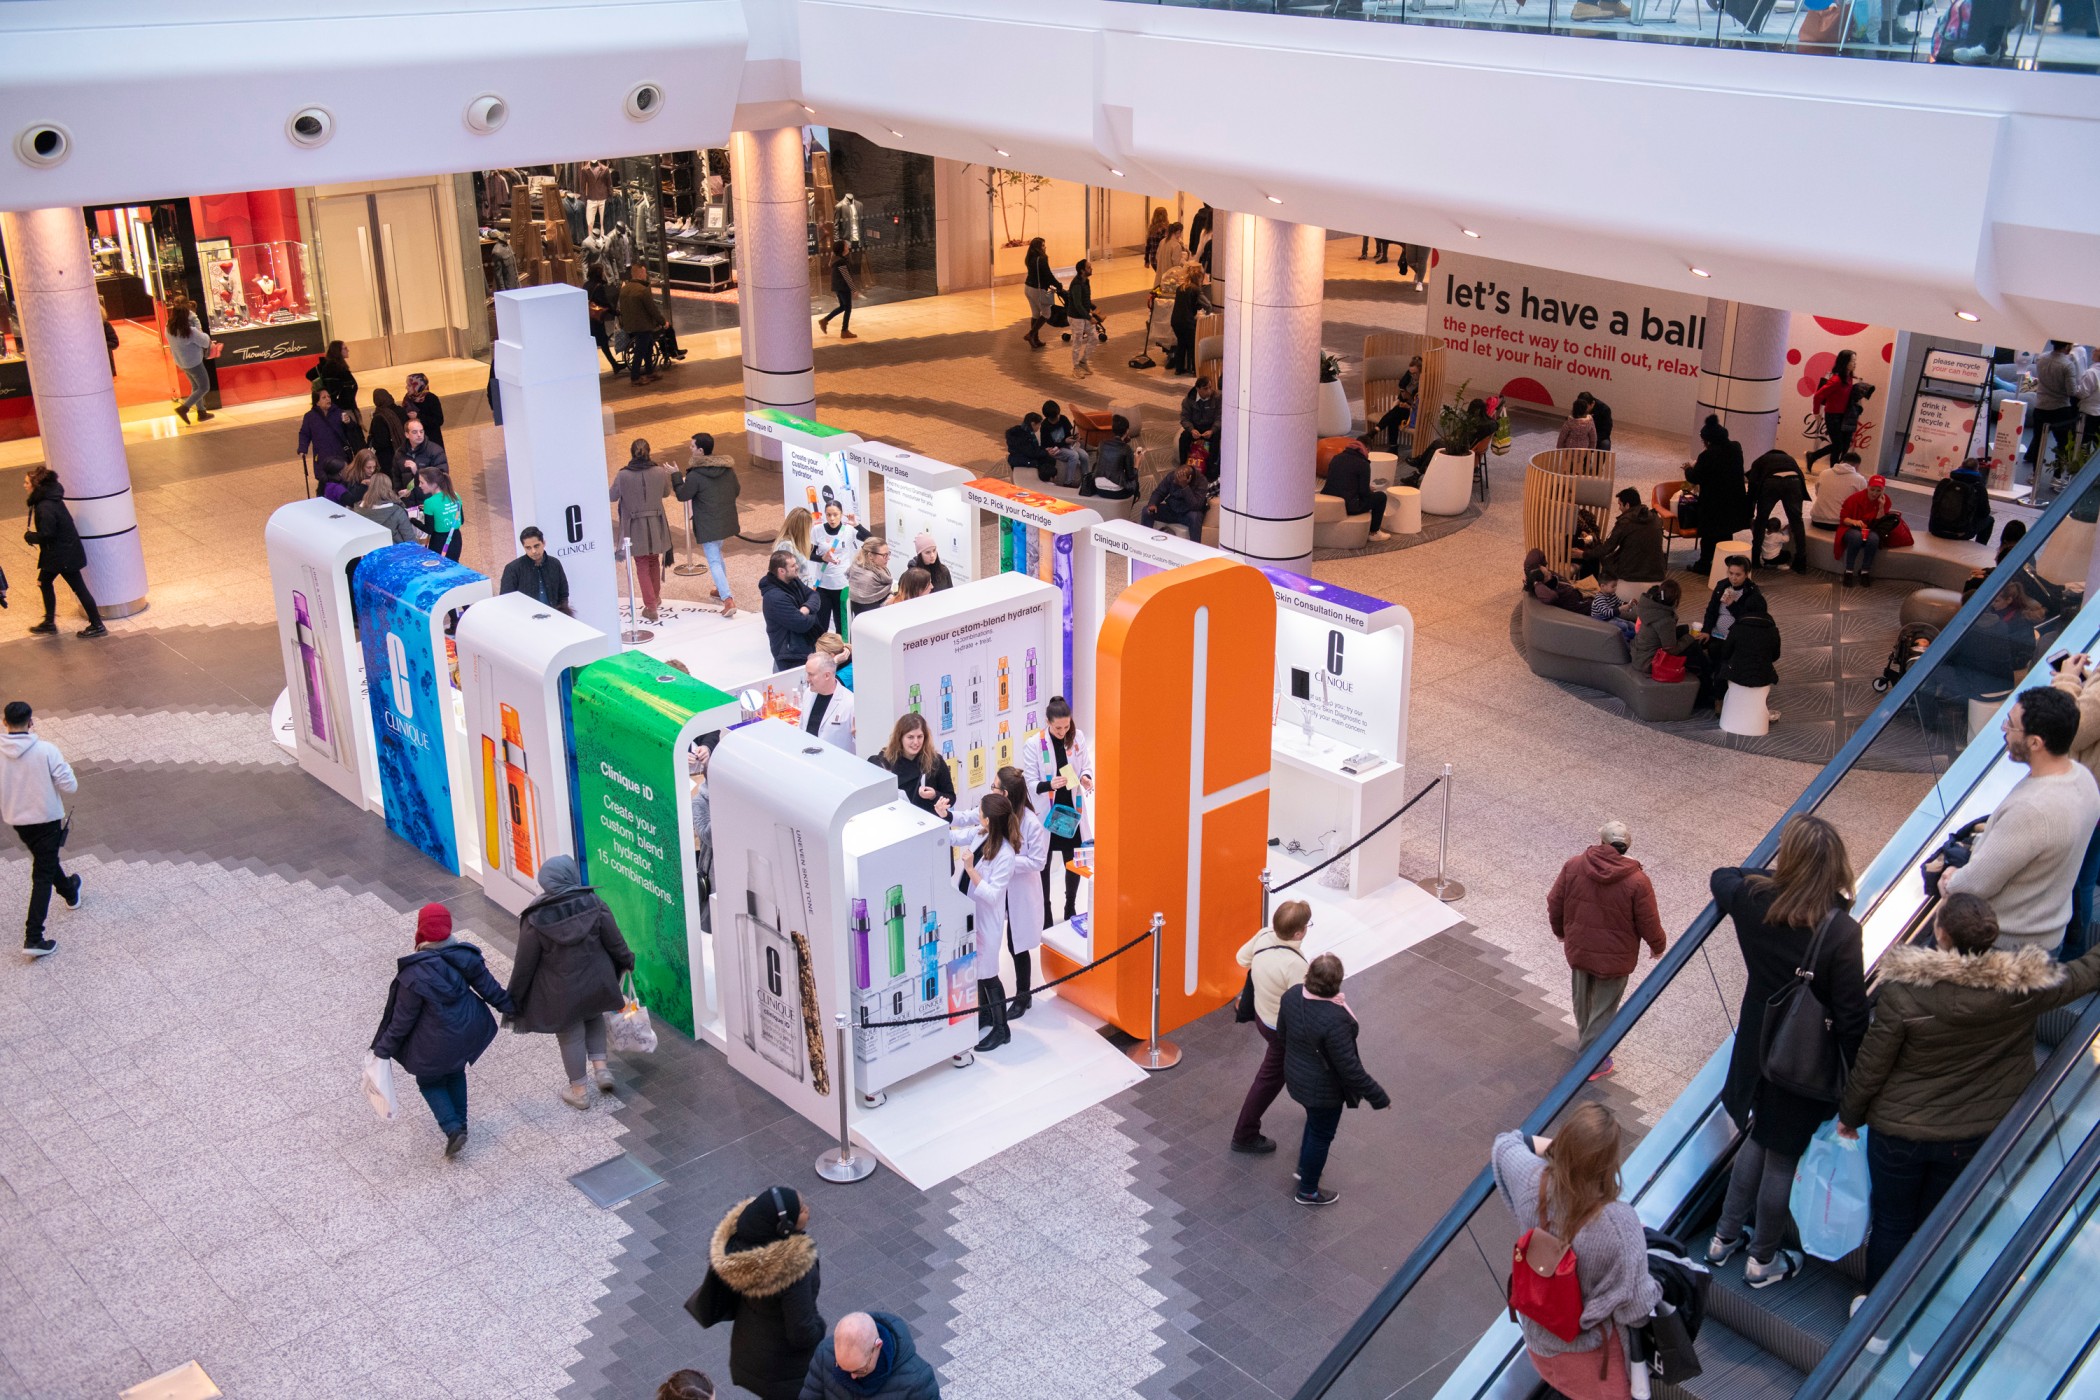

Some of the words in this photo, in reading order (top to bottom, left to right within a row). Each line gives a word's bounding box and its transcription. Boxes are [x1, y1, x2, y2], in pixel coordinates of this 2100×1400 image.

[1521, 286, 1599, 330] have
[1609, 310, 1629, 336] a
[1641, 307, 1706, 350] ball
[232, 345, 271, 360] Thomas
[270, 340, 307, 358] Sabo
[1443, 316, 1467, 333] the
[1471, 321, 1524, 344] perfect
[1529, 334, 1559, 351] way
[1563, 338, 1579, 354] to
[1583, 341, 1616, 362] chill
[1621, 352, 1652, 371] out,
[1657, 357, 1699, 378] relax
[1443, 337, 1469, 352] and
[1473, 341, 1492, 358] let
[1496, 347, 1530, 365] your
[1534, 353, 1563, 371] hair
[1567, 359, 1613, 381] down.
[1933, 357, 1955, 368] please
[1956, 361, 1981, 371] recycle
[1931, 365, 1948, 373] your
[1961, 369, 1979, 378] here.
[1918, 417, 1944, 428] recycle
[1920, 408, 1936, 417] love
[1921, 401, 1940, 410] drink
[746, 418, 768, 432] Clinique
[767, 424, 773, 433] iD
[791, 451, 807, 462] Create
[807, 457, 819, 466] your
[850, 452, 862, 464] Step
[863, 455, 868, 465] 1.
[868, 458, 881, 470] Pick
[880, 463, 894, 475] your
[894, 465, 909, 478] Base
[967, 491, 982, 505] Step
[983, 496, 989, 506] 2.
[990, 498, 1004, 511] Pick
[1005, 505, 1020, 516] your
[1021, 509, 1052, 527] Cartridge
[557, 541, 596, 557] CLINIQUE
[1093, 533, 1120, 549] Clinique
[1121, 541, 1129, 551] iD
[1129, 546, 1142, 556] Create
[1142, 550, 1152, 560] your
[930, 632, 949, 647] your
[1007, 604, 1043, 621] hydrator.
[1275, 591, 1292, 605] Skin
[1293, 597, 1343, 621] Consultation
[1345, 613, 1365, 628] Here
[384, 710, 430, 751] CLINIQUE
[600, 761, 640, 794] Clinique
[642, 784, 653, 801] iD
[603, 794, 634, 823] Create
[635, 815, 657, 836] your
[600, 814, 634, 843] custom
[637, 833, 664, 861] blend
[613, 838, 654, 874] hydrator.
[796, 829, 806, 866] UNEVEN
[802, 867, 810, 889] SKIN
[806, 891, 814, 915] TONE
[598, 848, 609, 864] 15
[610, 858, 675, 906] combinations.
[757, 989, 796, 1021] CLINIQUE
[951, 985, 976, 1009] VE
